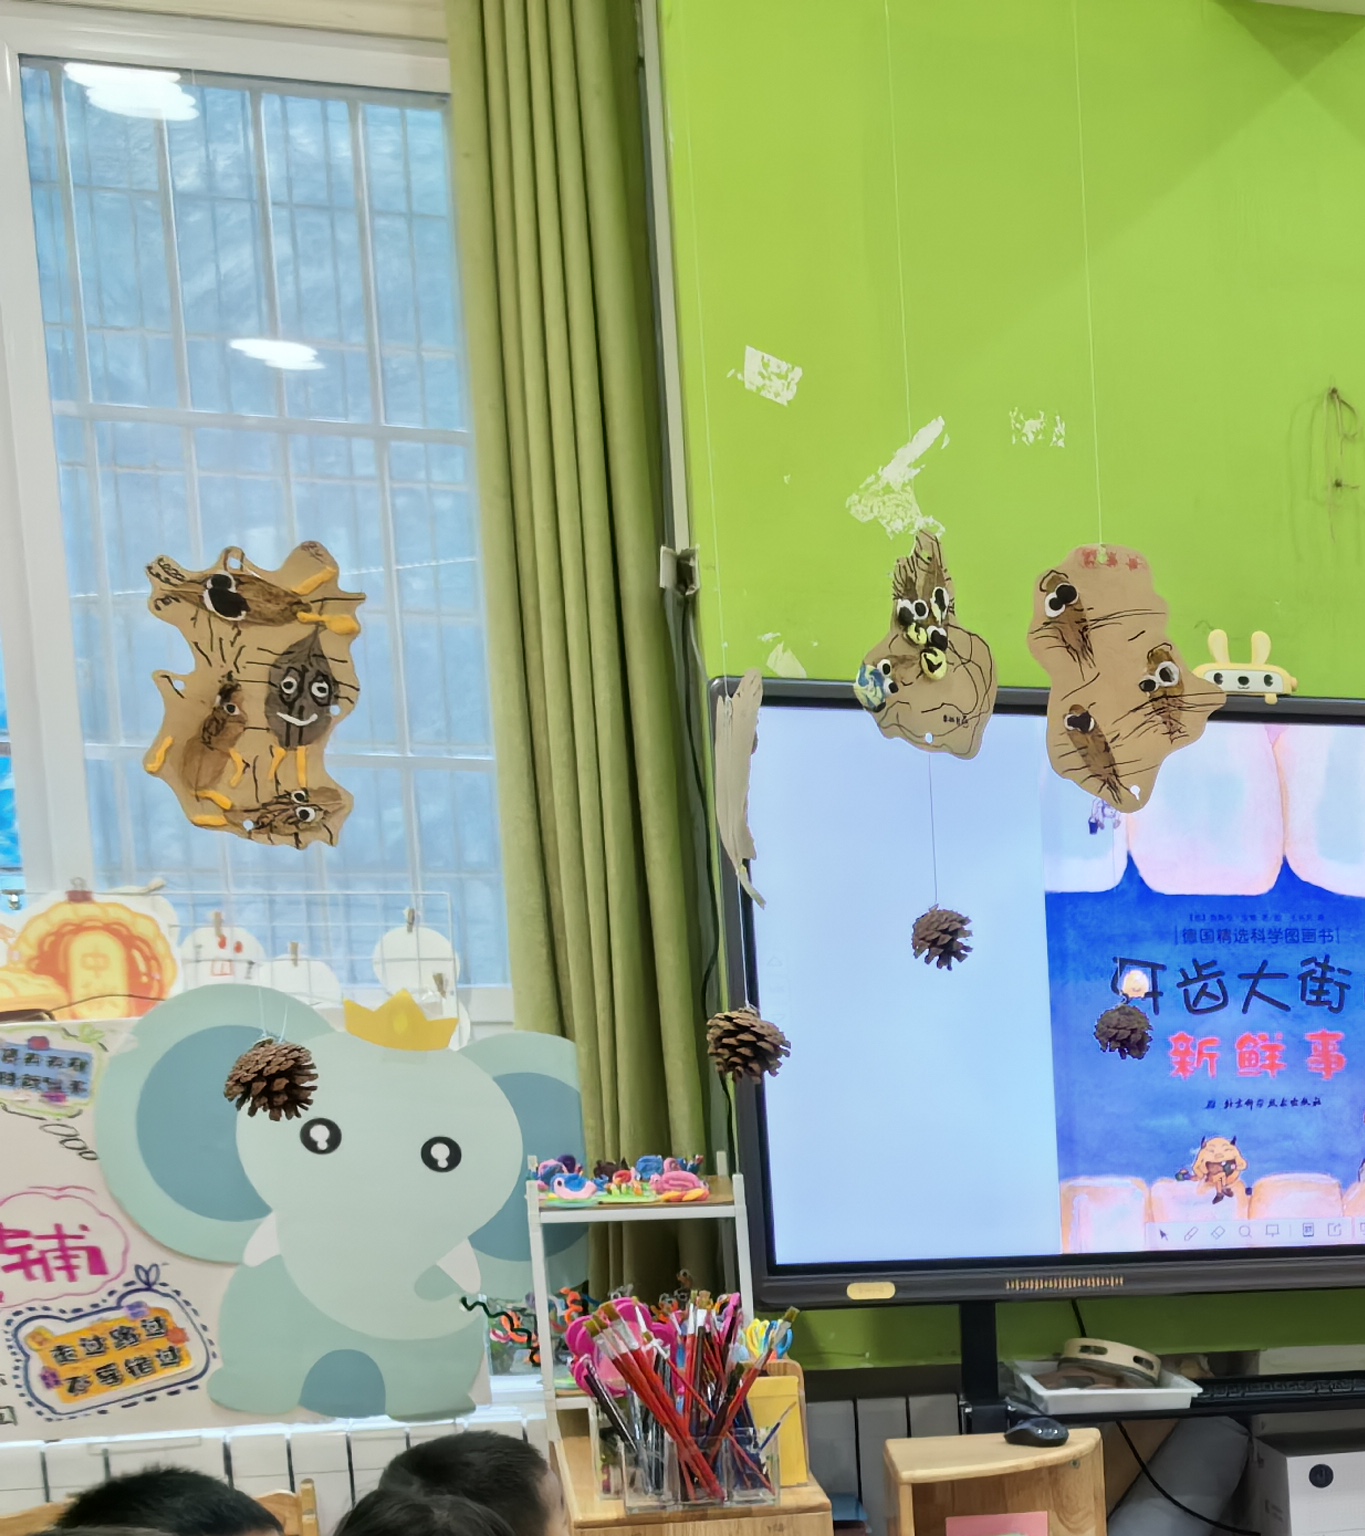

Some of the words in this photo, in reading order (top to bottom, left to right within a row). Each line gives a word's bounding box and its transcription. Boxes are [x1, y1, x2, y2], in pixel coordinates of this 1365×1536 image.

[1182, 927, 1335, 944] 德国精选科学图画书
[1168, 1028, 1346, 1080] 新鲜事
